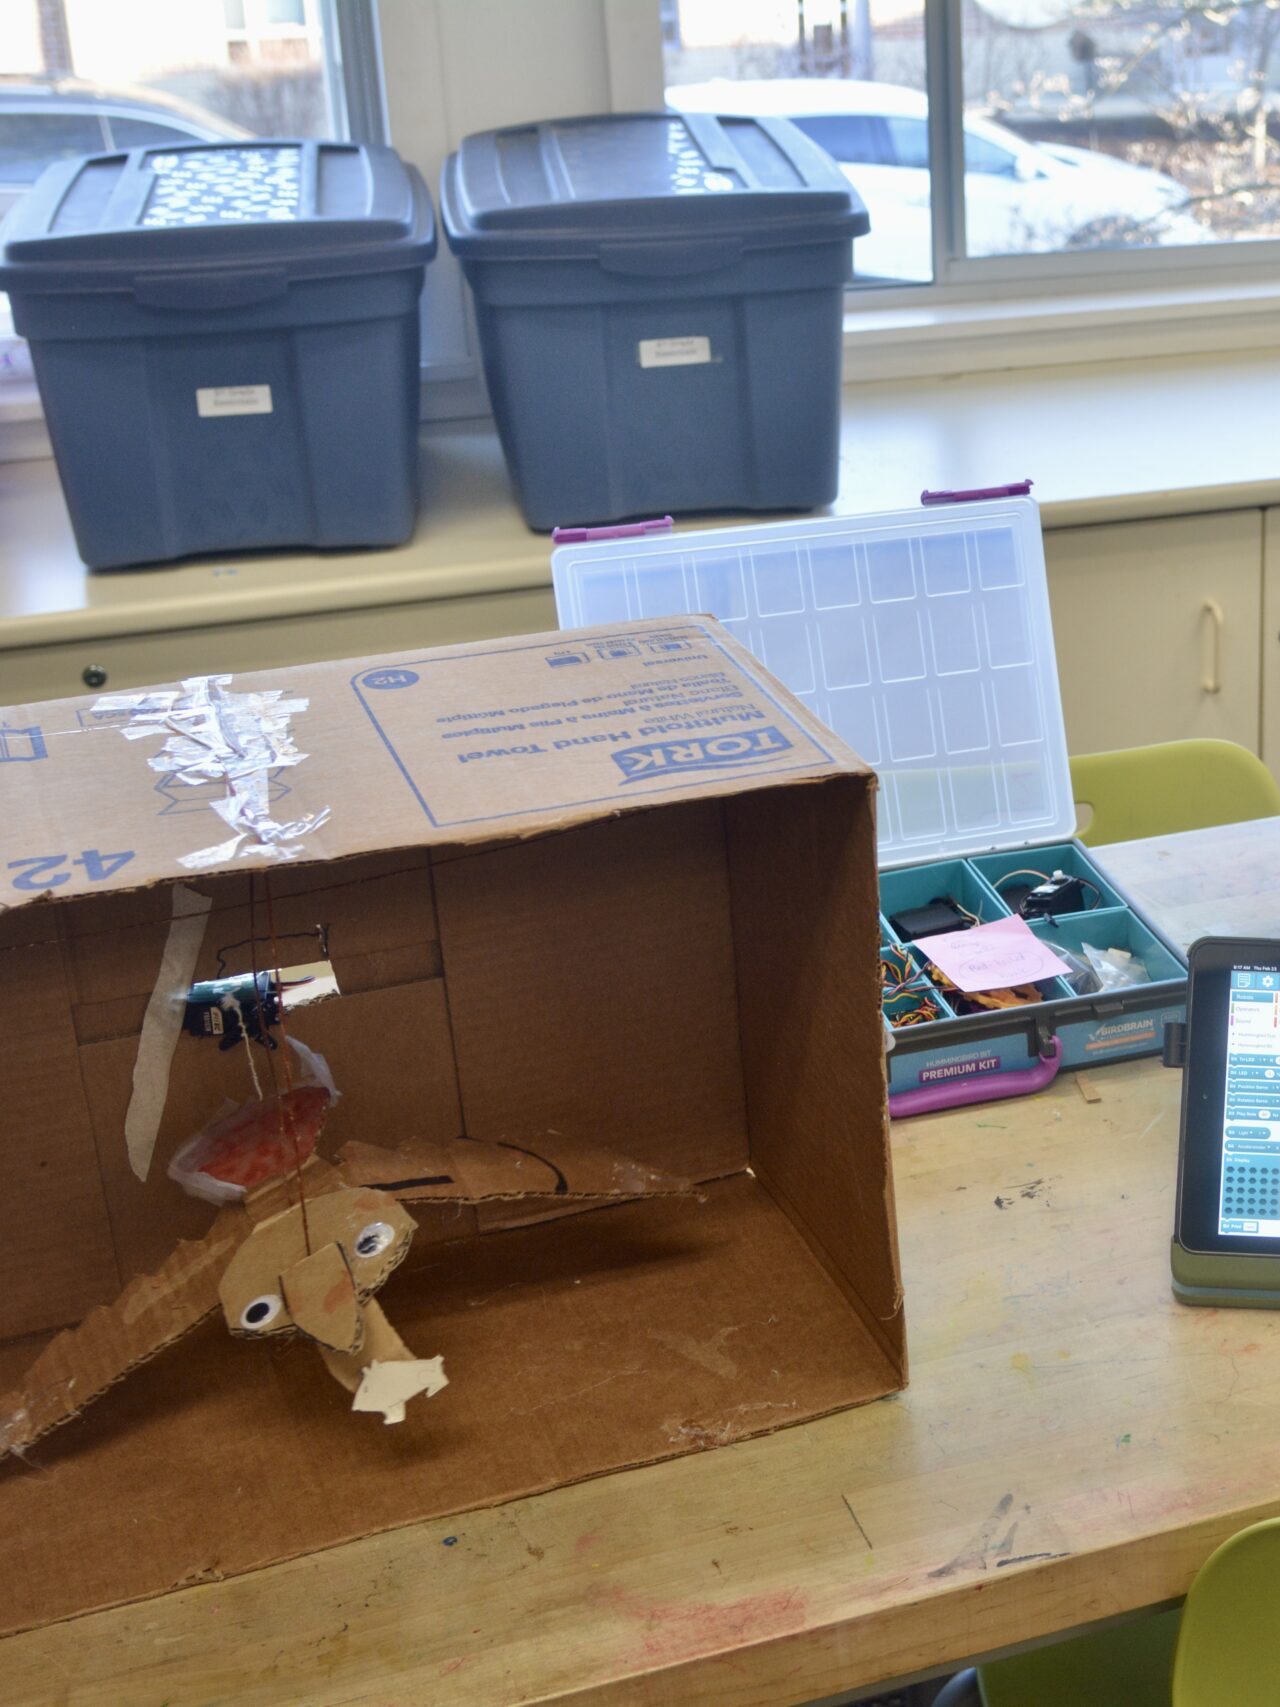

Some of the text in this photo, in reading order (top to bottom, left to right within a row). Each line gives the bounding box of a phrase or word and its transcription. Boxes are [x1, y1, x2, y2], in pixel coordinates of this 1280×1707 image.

[643, 655, 708, 667] Universal
[372, 674, 407, 685] H2
[682, 677, 731, 688] Toalla
[608, 687, 654, 700] Mano
[657, 684, 676, 692] de
[690, 684, 740, 696] Blanc
[581, 695, 604, 706] de
[655, 691, 743, 708] Serviettes
[509, 700, 579, 715] Plegado
[581, 706, 637, 721] Mains
[644, 703, 755, 725] Natural White
[441, 721, 525, 740] Multiples
[530, 717, 563, 729] Plis
[456, 711, 767, 764] Multifold Hand Towel
[627, 731, 786, 772] TORK
[7, 850, 136, 890] 42
[1100, 1019, 1154, 1036] BIRDBRAIN
[922, 1059, 997, 1081] PREMIUM KIT
